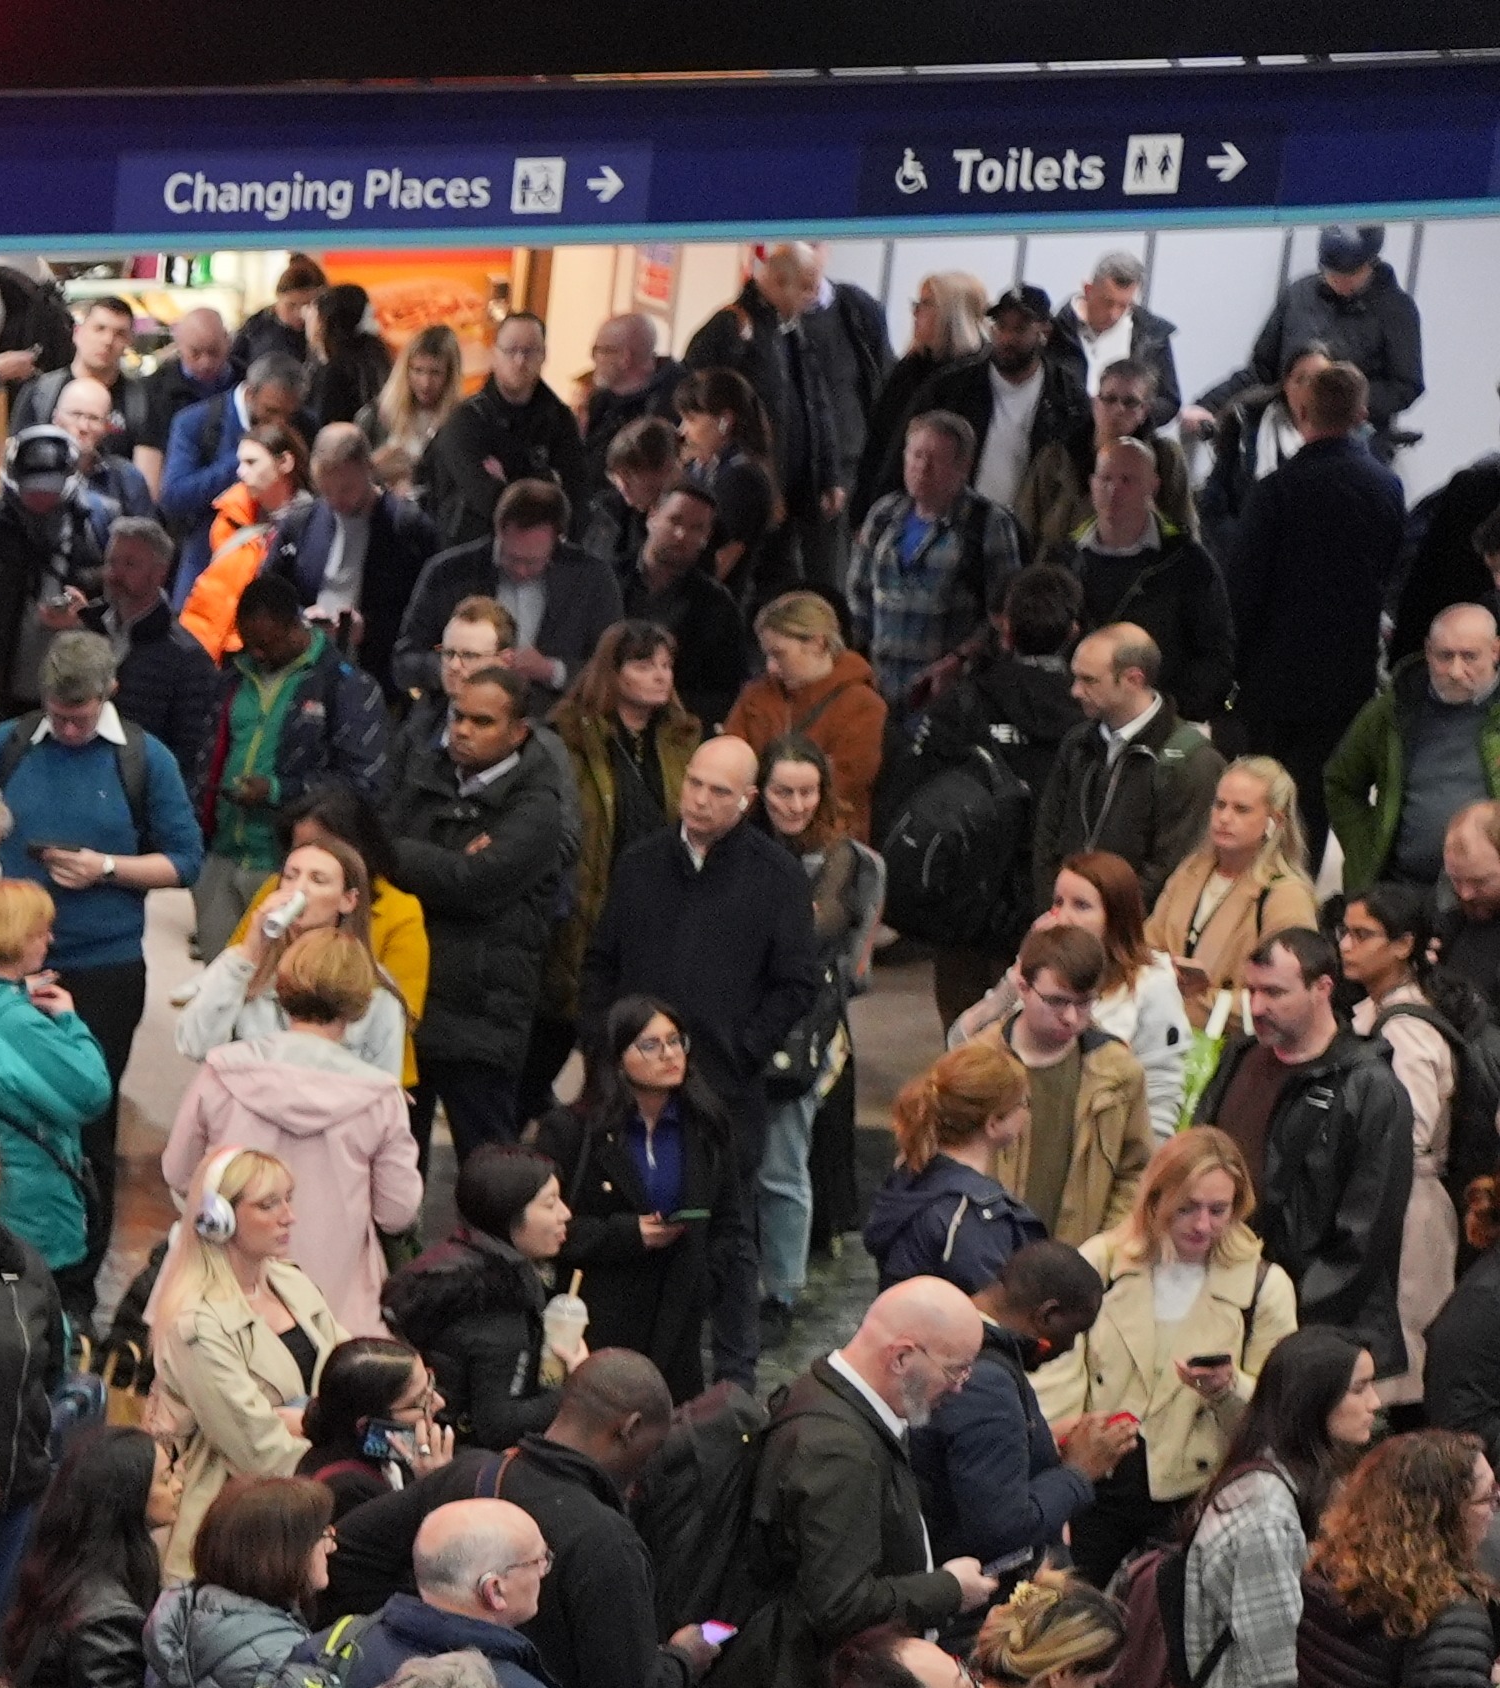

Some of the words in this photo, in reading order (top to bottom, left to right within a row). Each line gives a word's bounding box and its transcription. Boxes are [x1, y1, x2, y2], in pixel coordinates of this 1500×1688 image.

[162, 169, 355, 221] Changing
[362, 166, 492, 211] Places
[951, 146, 1106, 195] Toilets
